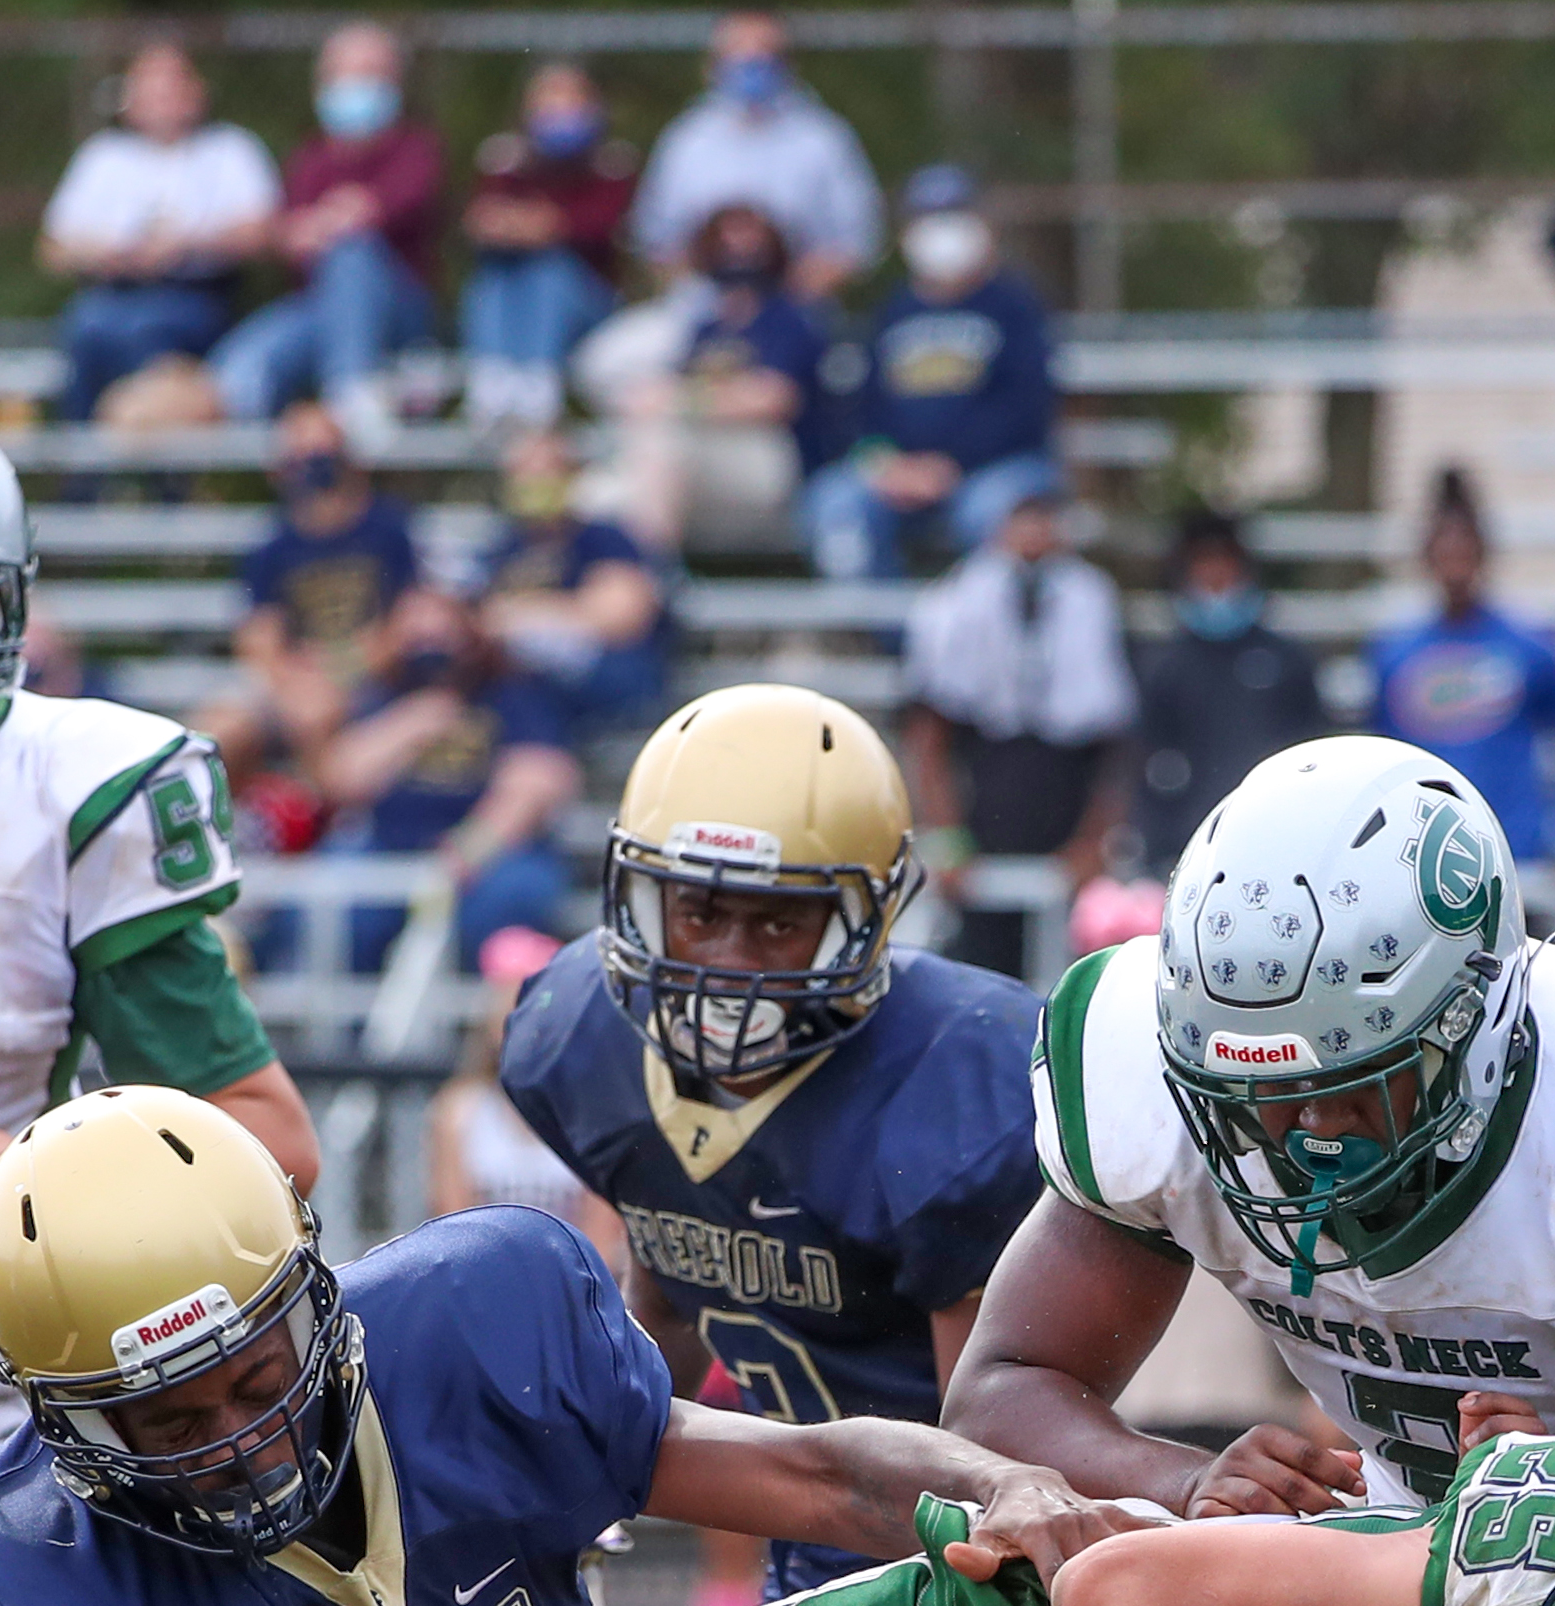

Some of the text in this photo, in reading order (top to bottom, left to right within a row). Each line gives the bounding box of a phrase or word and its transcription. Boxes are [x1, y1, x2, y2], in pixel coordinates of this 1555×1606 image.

[695, 828, 756, 850] Riddell
[1214, 1041, 1299, 1064] Riddell
[137, 1300, 208, 1347] Riddell
[1247, 1297, 1542, 1380] COLTS NECK
